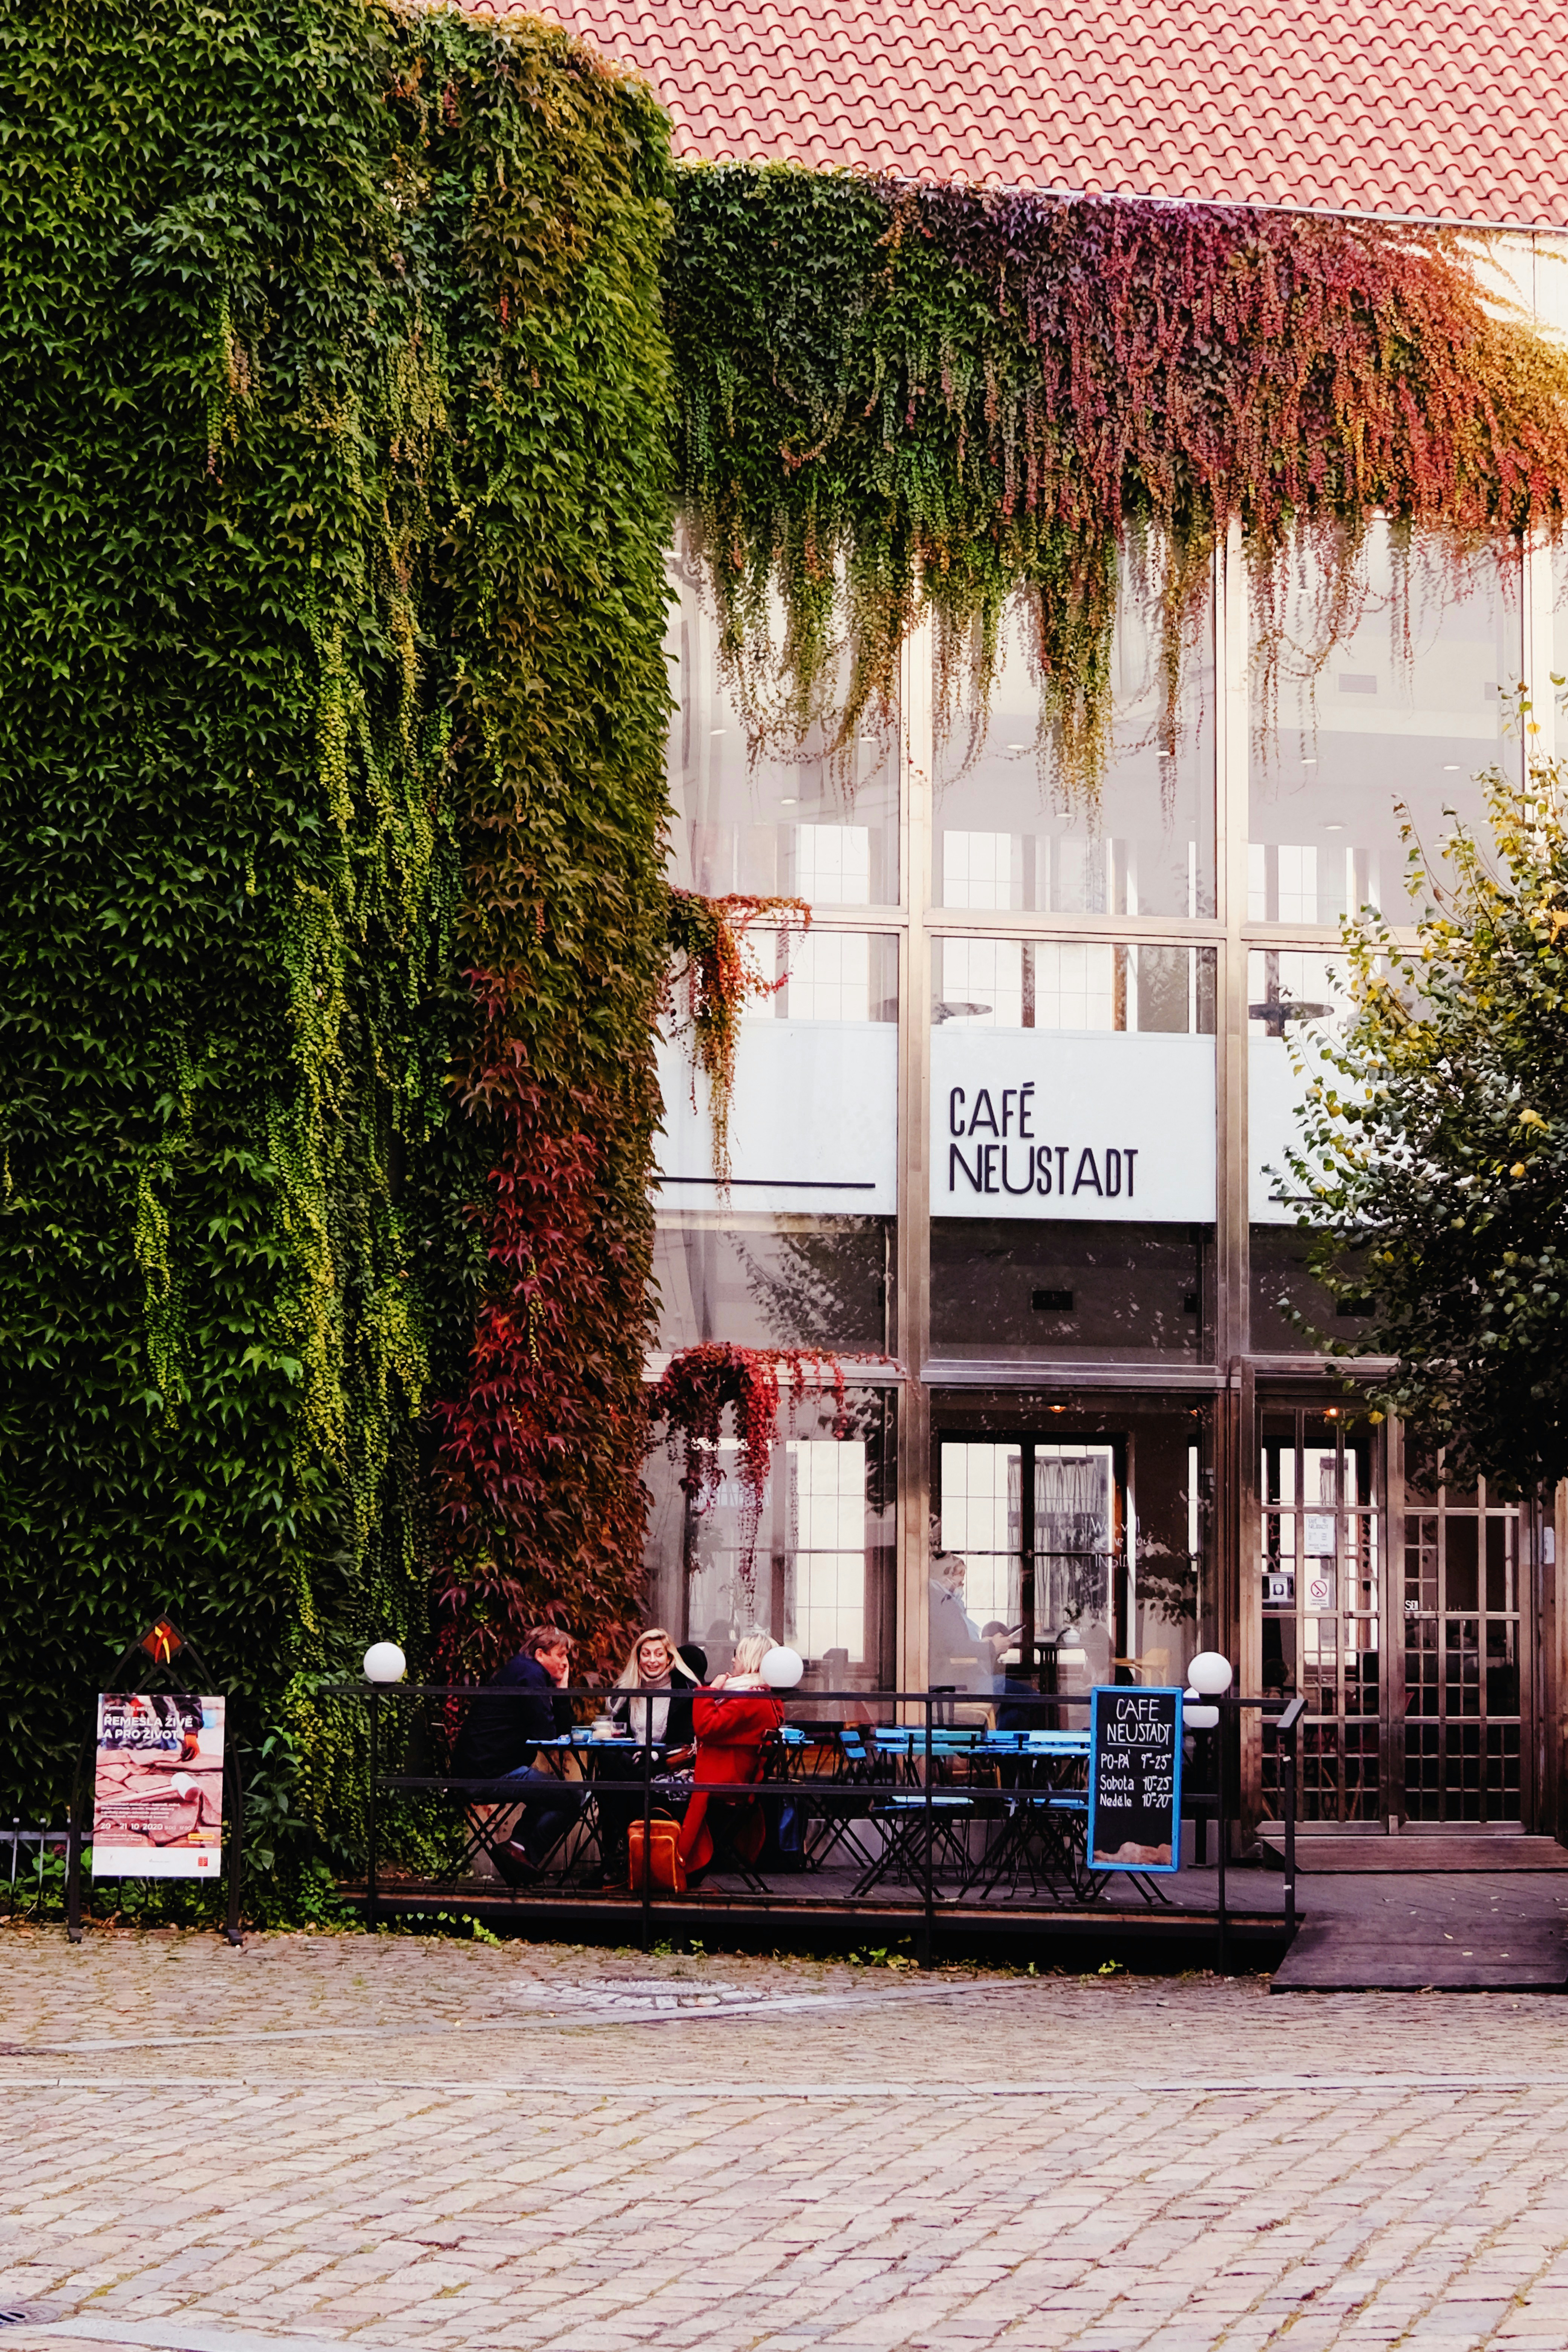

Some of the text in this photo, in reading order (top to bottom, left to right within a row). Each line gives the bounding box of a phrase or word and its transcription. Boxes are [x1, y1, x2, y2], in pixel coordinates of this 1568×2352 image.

[949, 1081, 1035, 1138] CAFÉ
[949, 1143, 1139, 1197] NEUSTADT
[104, 1713, 193, 1727] ŘEMESLA ŽIVĚ
[1116, 1698, 1160, 1721] CAFE
[103, 1727, 178, 1740] A PRO ŽIVOT
[1107, 1723, 1172, 1746] NEUSTADT
[1100, 1774, 1135, 1790] Sobota
